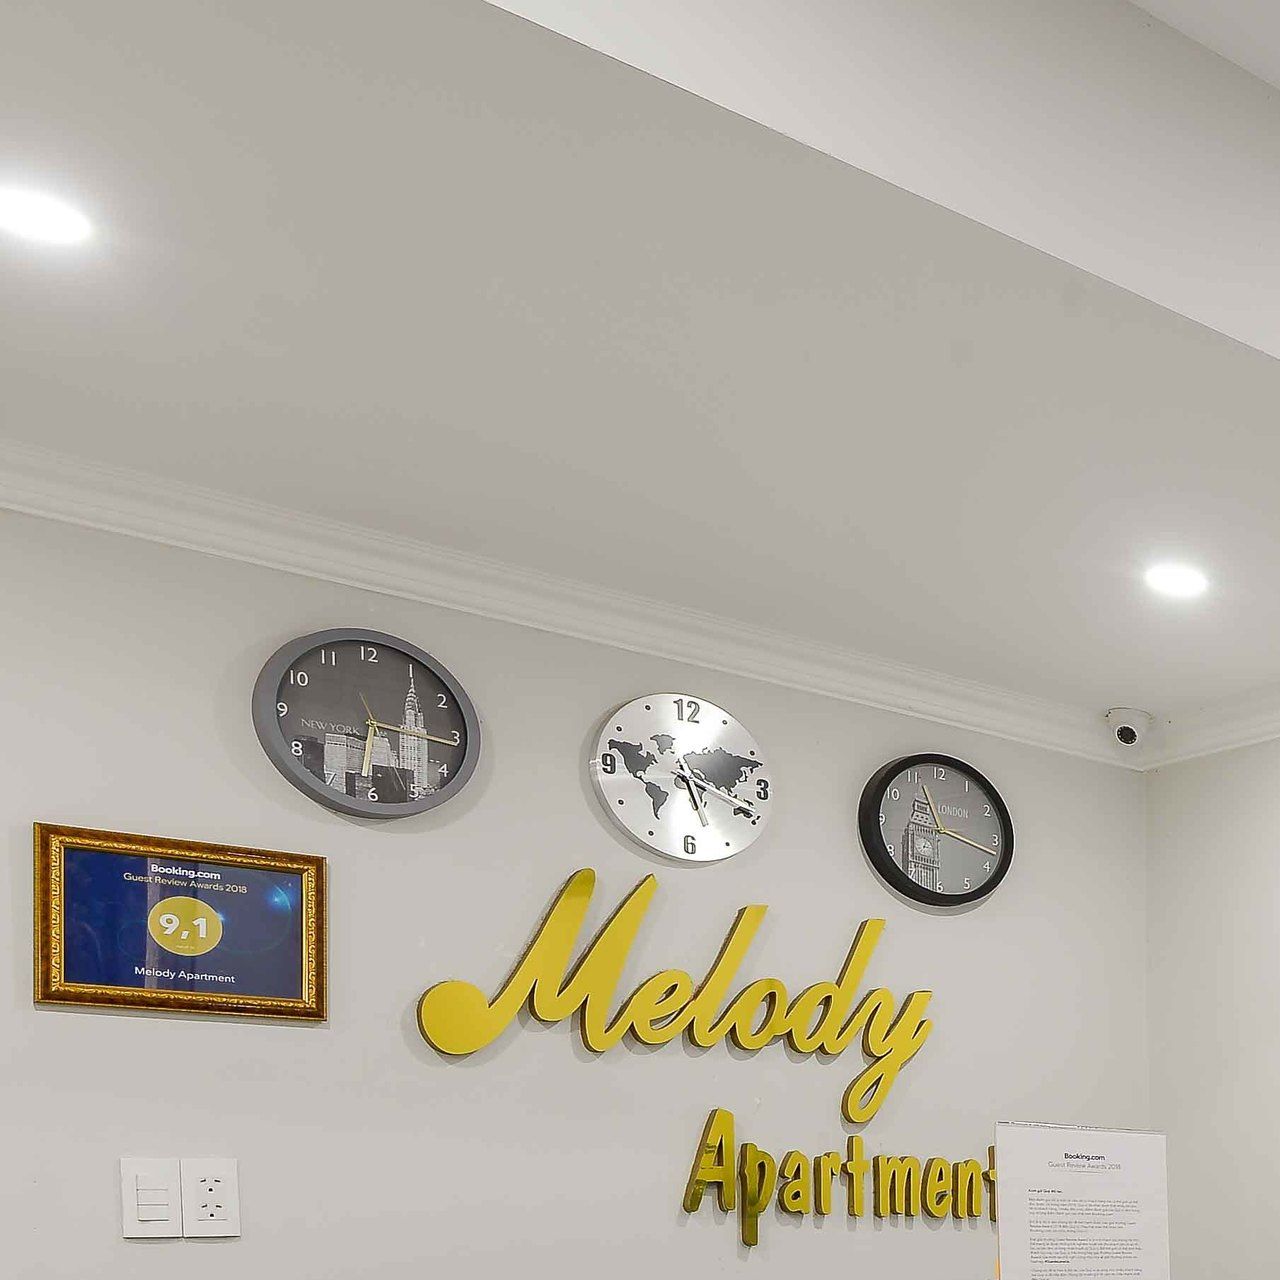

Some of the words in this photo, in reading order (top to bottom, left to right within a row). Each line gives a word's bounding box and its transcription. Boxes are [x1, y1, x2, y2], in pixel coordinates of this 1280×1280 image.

[320, 649, 336, 666] 11
[360, 645, 379, 663] 12
[289, 669, 309, 687] 10
[436, 693, 448, 709] 2
[276, 701, 288, 718] 9
[672, 698, 700, 724] 12
[301, 718, 328, 732] NEW
[329, 722, 360, 736] YORK
[451, 730, 460, 747] 3
[291, 740, 303, 757] 8
[437, 762, 449, 778] 4
[601, 752, 618, 775] 9
[325, 772, 337, 786] 7
[906, 770, 918, 784] 11
[932, 766, 946, 781] 12
[366, 787, 379, 802] 6
[408, 784, 419, 799] 5
[755, 778, 770, 801] 3
[886, 787, 900, 801] 10
[937, 803, 970, 819] LONDON
[982, 804, 991, 818] 2
[683, 834, 697, 855] 6
[991, 834, 999, 847] 3
[150, 864, 222, 880] Booking.com
[982, 861, 991, 874] 4
[123, 872, 153, 884] Guest
[154, 876, 188, 887] Review
[189, 880, 224, 893] Awards
[225, 884, 248, 894] 2018
[936, 880, 944, 893] 6
[963, 877, 971, 890] 5
[159, 912, 208, 940] 9,1
[134, 966, 176, 981] Melody
[178, 970, 236, 984] Apartment
[417, 867, 933, 1125] Melody
[1064, 1152, 1105, 1162] Booking.com
